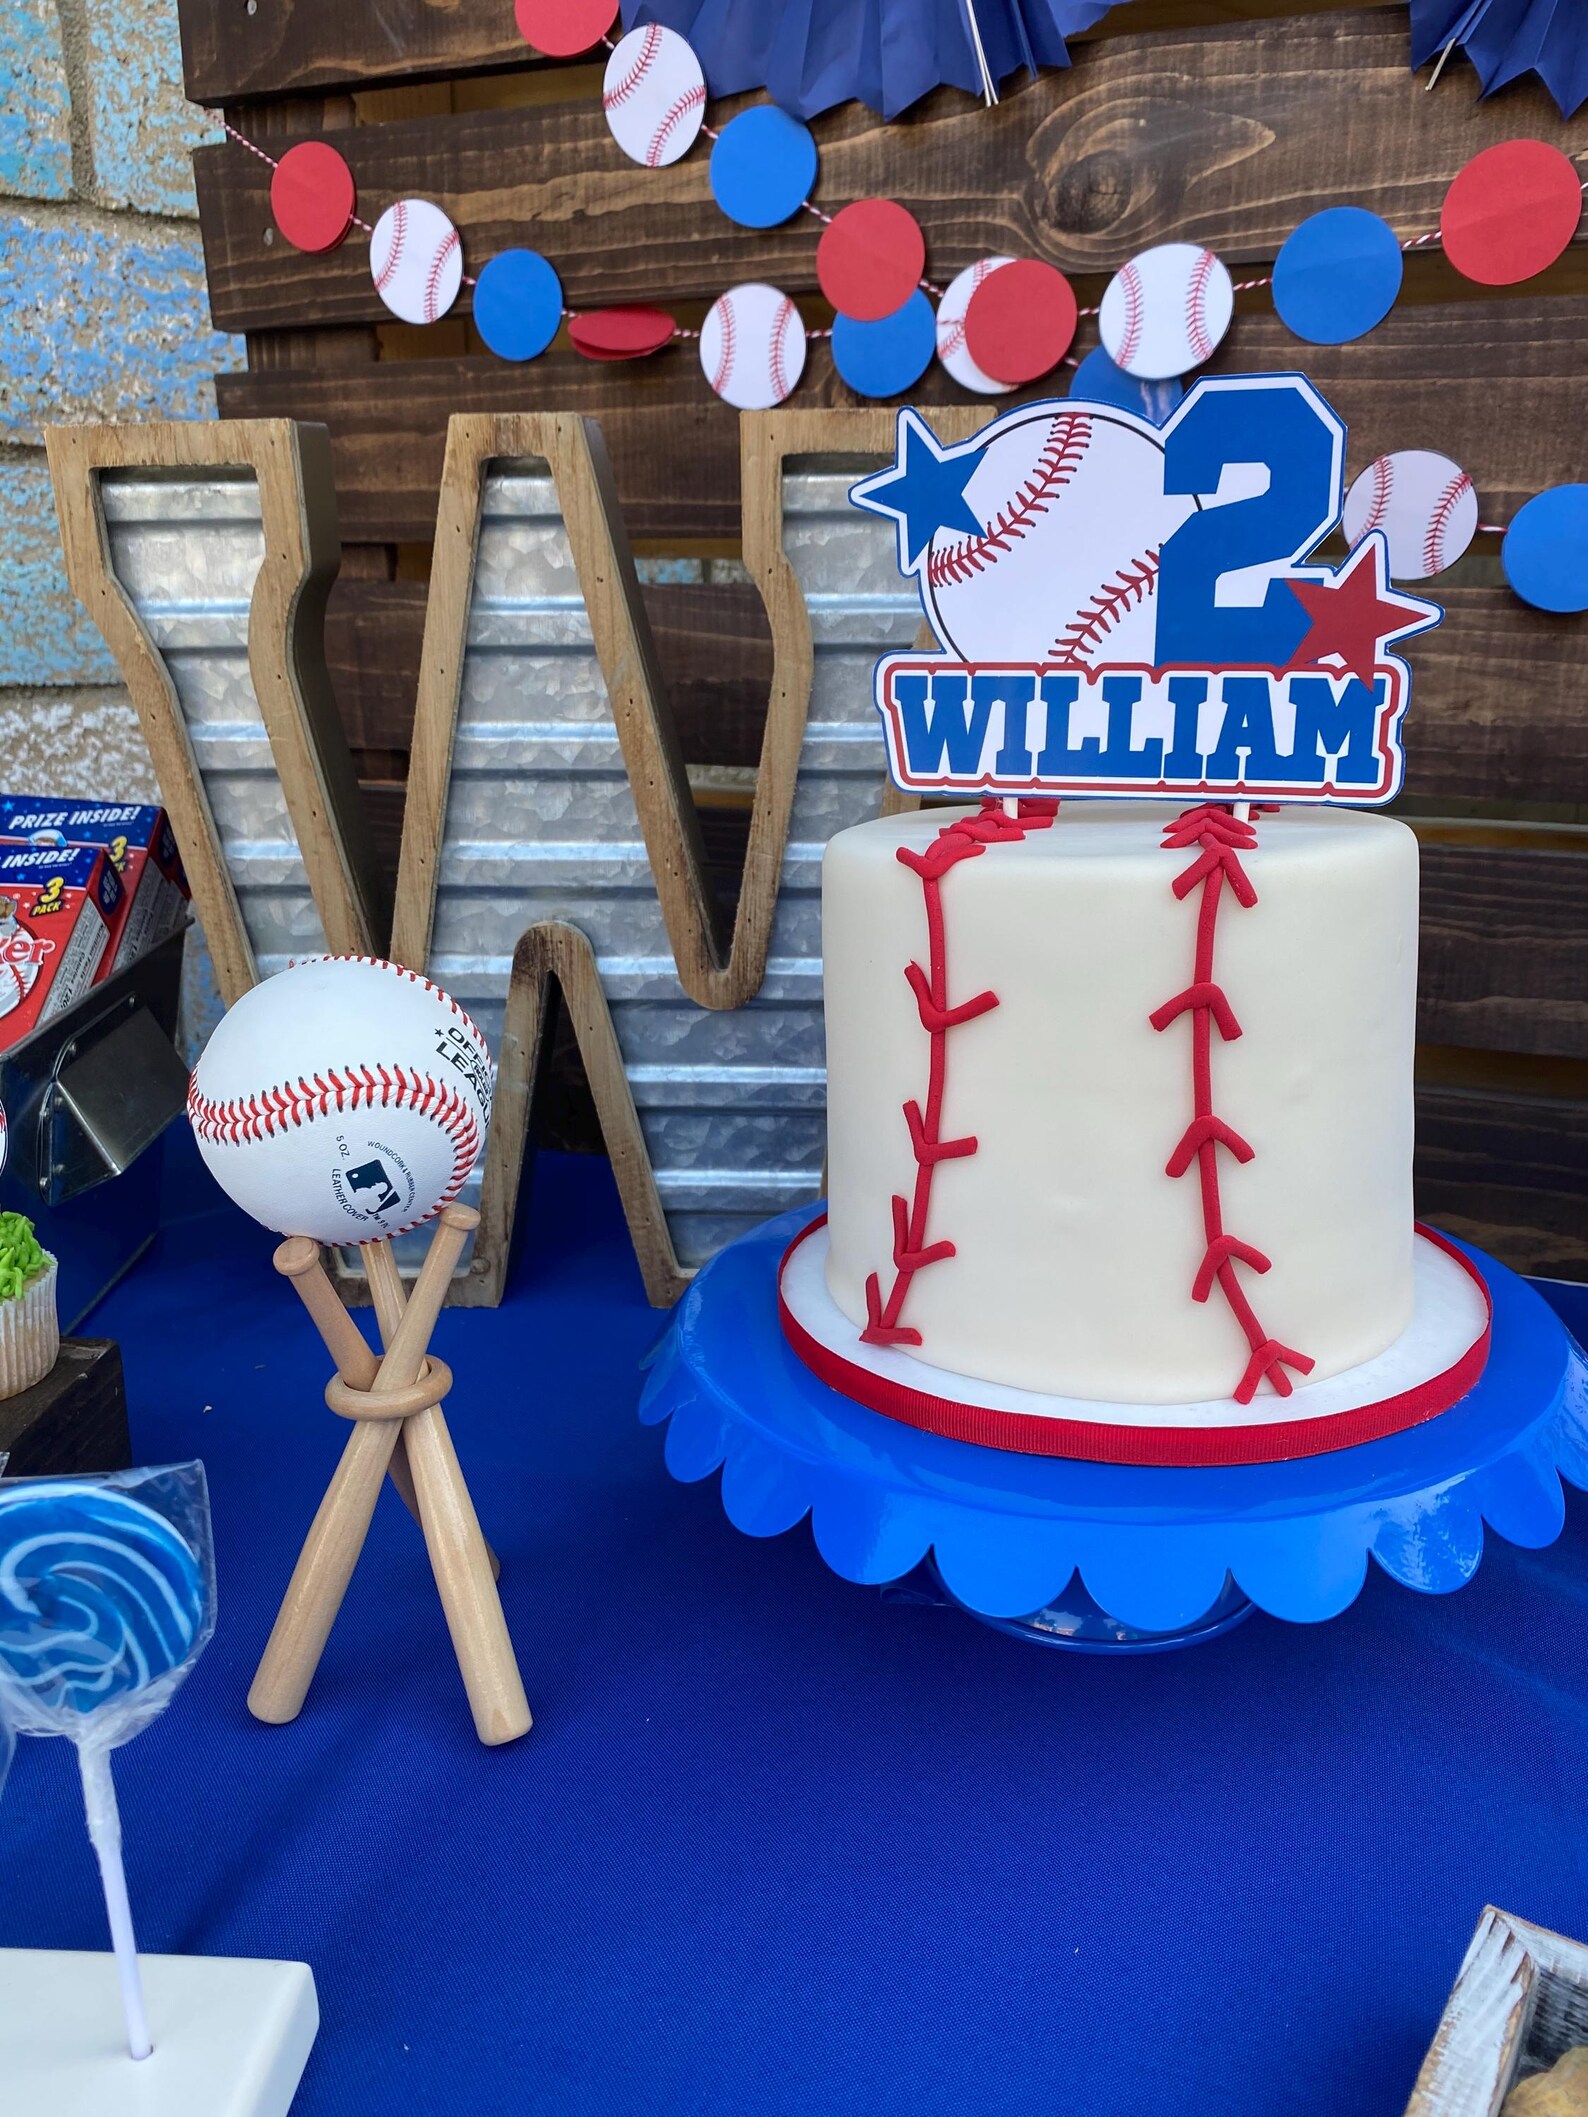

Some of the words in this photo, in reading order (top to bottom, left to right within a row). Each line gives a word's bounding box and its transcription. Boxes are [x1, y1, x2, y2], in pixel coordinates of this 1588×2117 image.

[1153, 387, 1335, 667] 2
[894, 675, 1386, 784] WILLIAM
[8, 812, 69, 830] PRIZE
[69, 806, 142, 826] INSIDE!
[1, 848, 81, 869] INSIDE!
[110, 835, 128, 862] 3
[39, 876, 64, 903] 3
[31, 901, 62, 916] PACK
[331, 1168, 348, 1205] LEATHER
[343, 1203, 369, 1222] COVER
